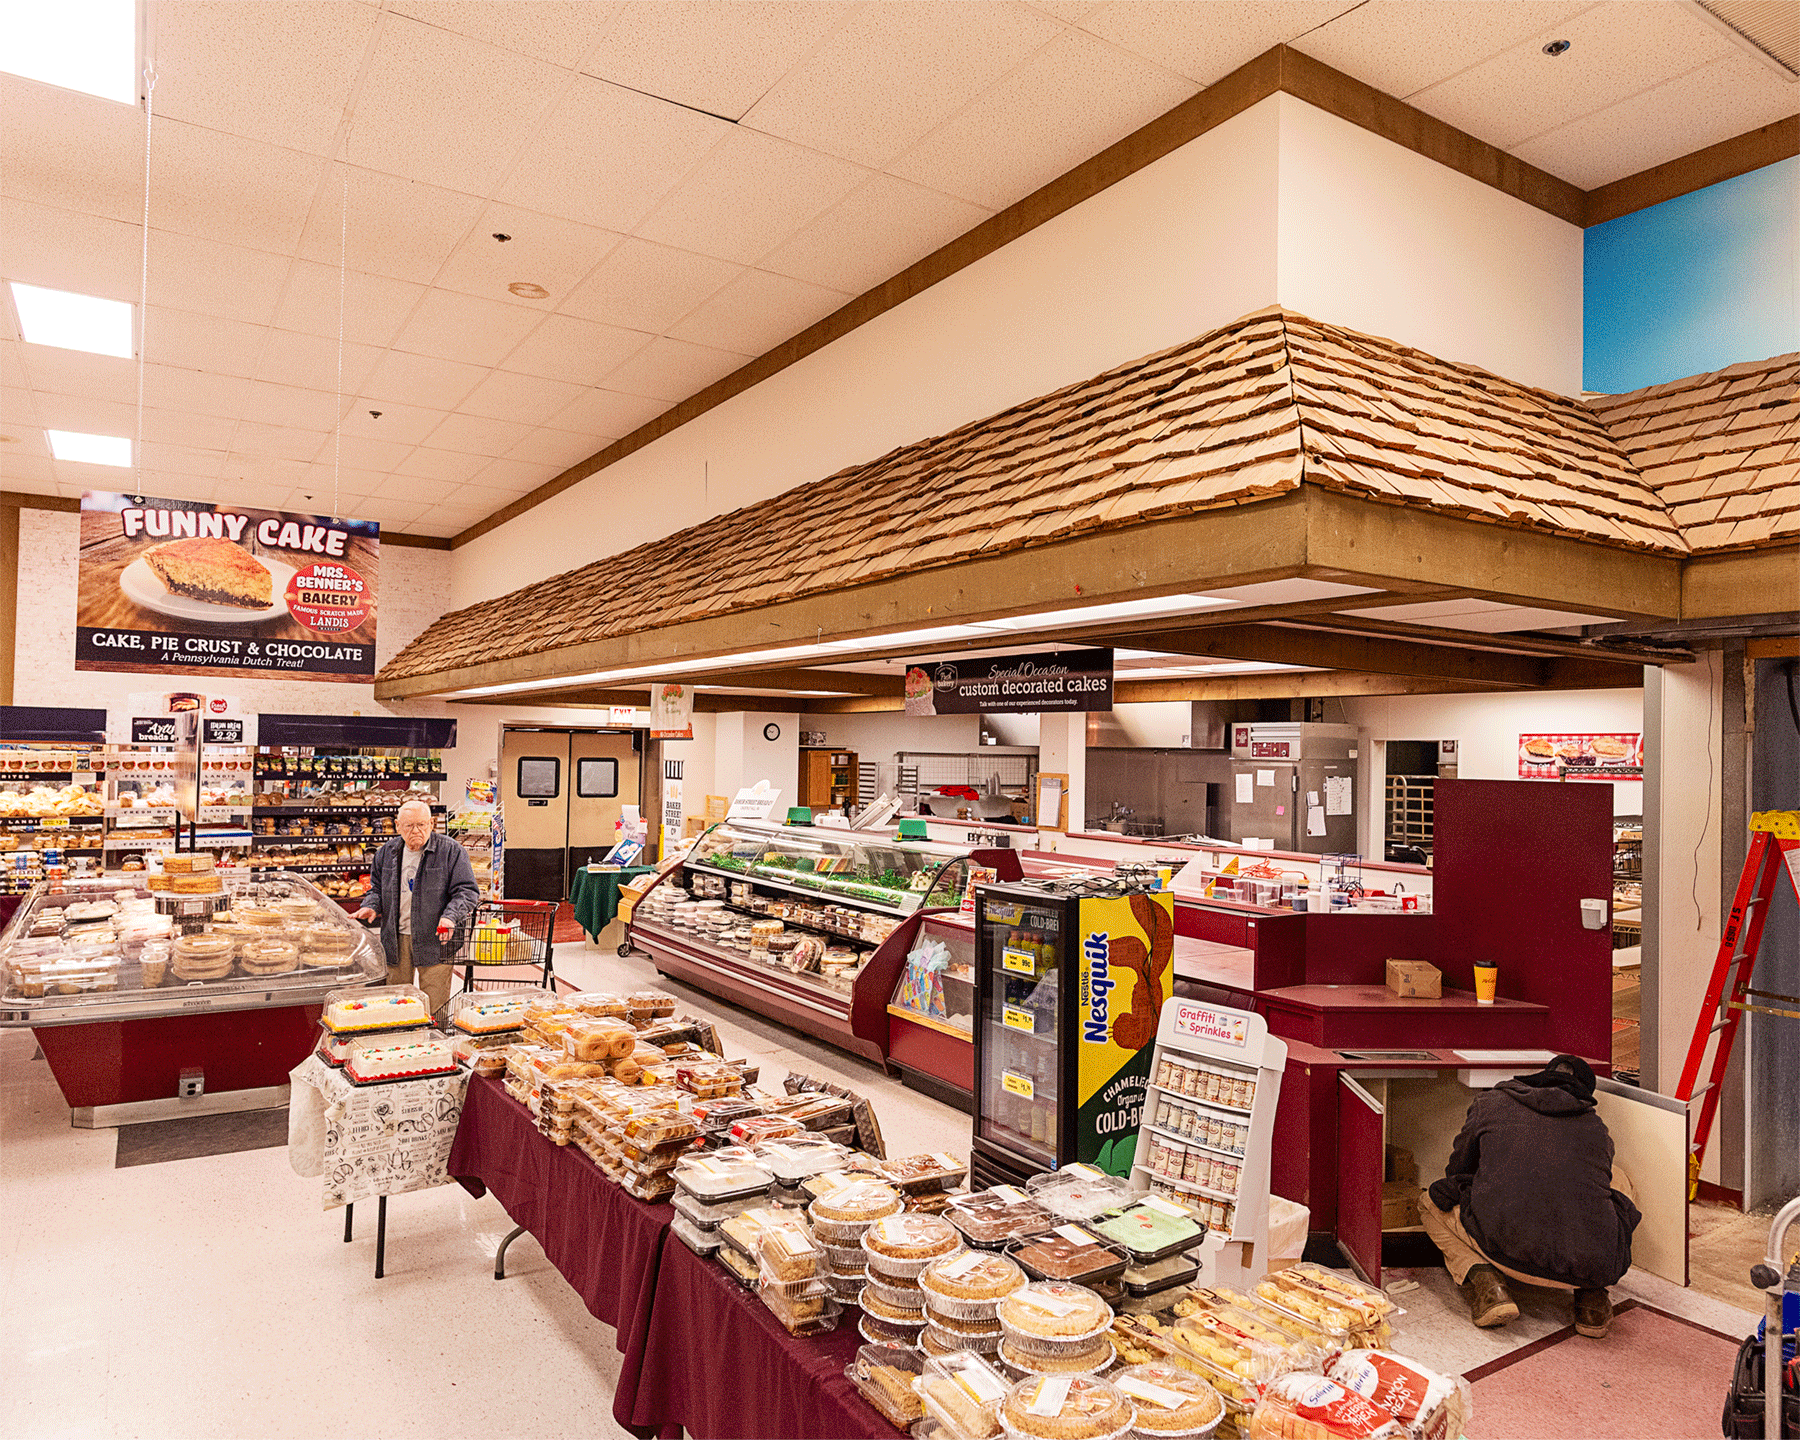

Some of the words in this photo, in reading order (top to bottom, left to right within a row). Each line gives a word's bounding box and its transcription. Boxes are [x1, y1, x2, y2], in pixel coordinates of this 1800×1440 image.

[122, 508, 248, 541] FUNNY
[257, 518, 348, 557] CAKE
[313, 565, 349, 579] MRS.
[296, 576, 364, 592] BENNER'S
[302, 592, 357, 606] BAKERY
[293, 604, 318, 615] FAMOUS
[310, 616, 349, 628] LANDIS
[91, 632, 145, 650] CAKE,
[150, 636, 179, 651] PIE
[184, 638, 242, 655] CRUST
[247, 642, 260, 655] &
[265, 643, 363, 661] CHOCOLATE
[160, 652, 169, 661] A
[172, 652, 240, 665] Pennsylvania
[242, 656, 273, 667] Dutch
[276, 658, 304, 668] Treat!
[987, 662, 1025, 684] Special
[1024, 661, 1069, 678] Occasion
[959, 683, 1000, 697] custom
[1001, 677, 1064, 695] decorated
[1066, 675, 1108, 692] cakes
[666, 801, 682, 809] BAKER
[665, 809, 682, 818] STREET
[666, 818, 681, 827] BREAD
[1084, 932, 1115, 1043] Nesquik
[1179, 1008, 1216, 1024] Graffiti
[1189, 1022, 1231, 1039] Sprinkles
